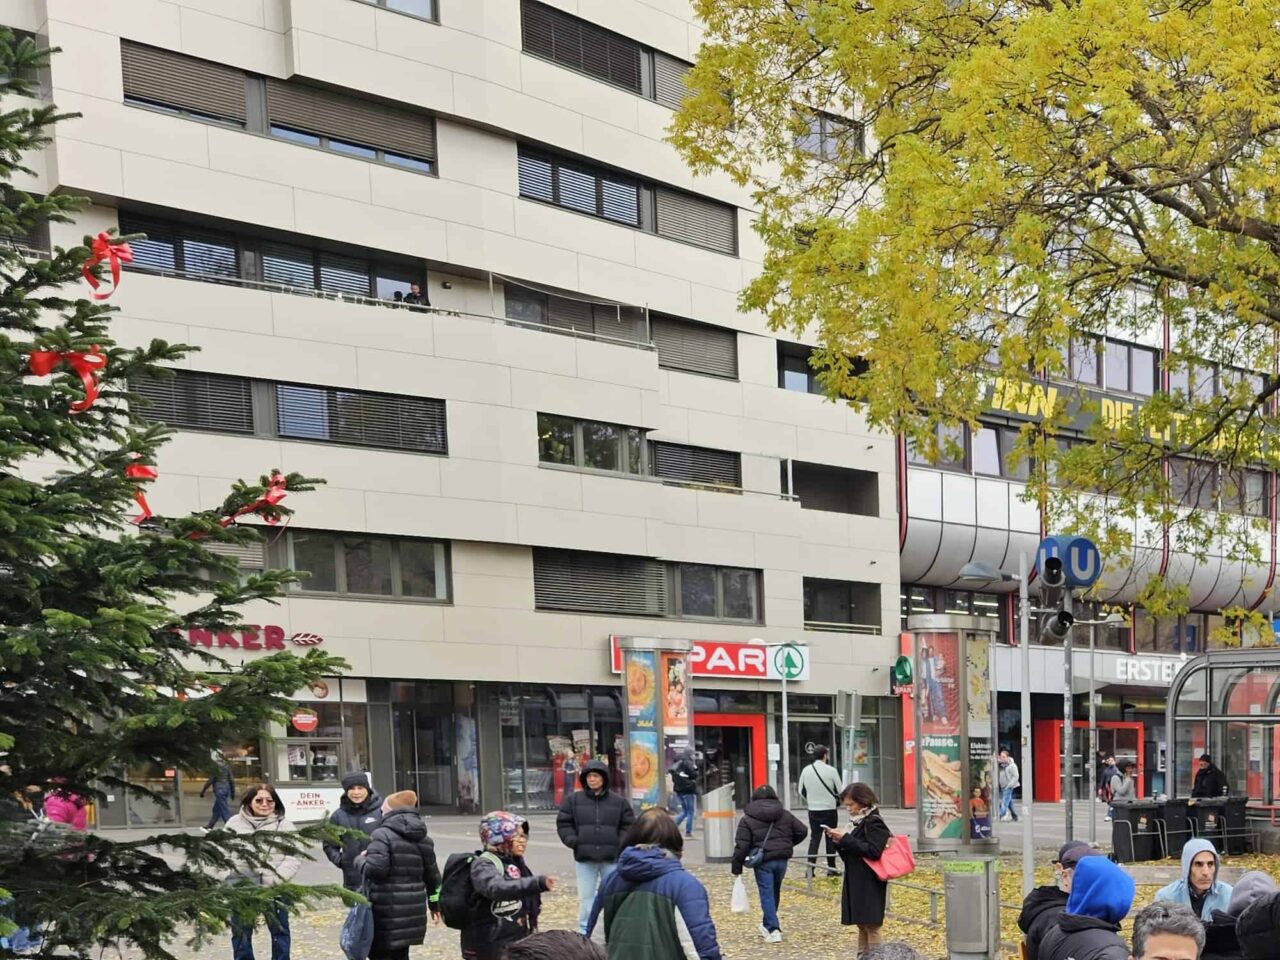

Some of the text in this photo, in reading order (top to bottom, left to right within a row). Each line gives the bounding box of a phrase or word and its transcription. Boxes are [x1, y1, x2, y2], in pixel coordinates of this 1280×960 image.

[1101, 398, 1134, 431] DIE
[1071, 547, 1094, 580] U
[172, 624, 286, 651] NKER
[689, 645, 765, 672] PAR
